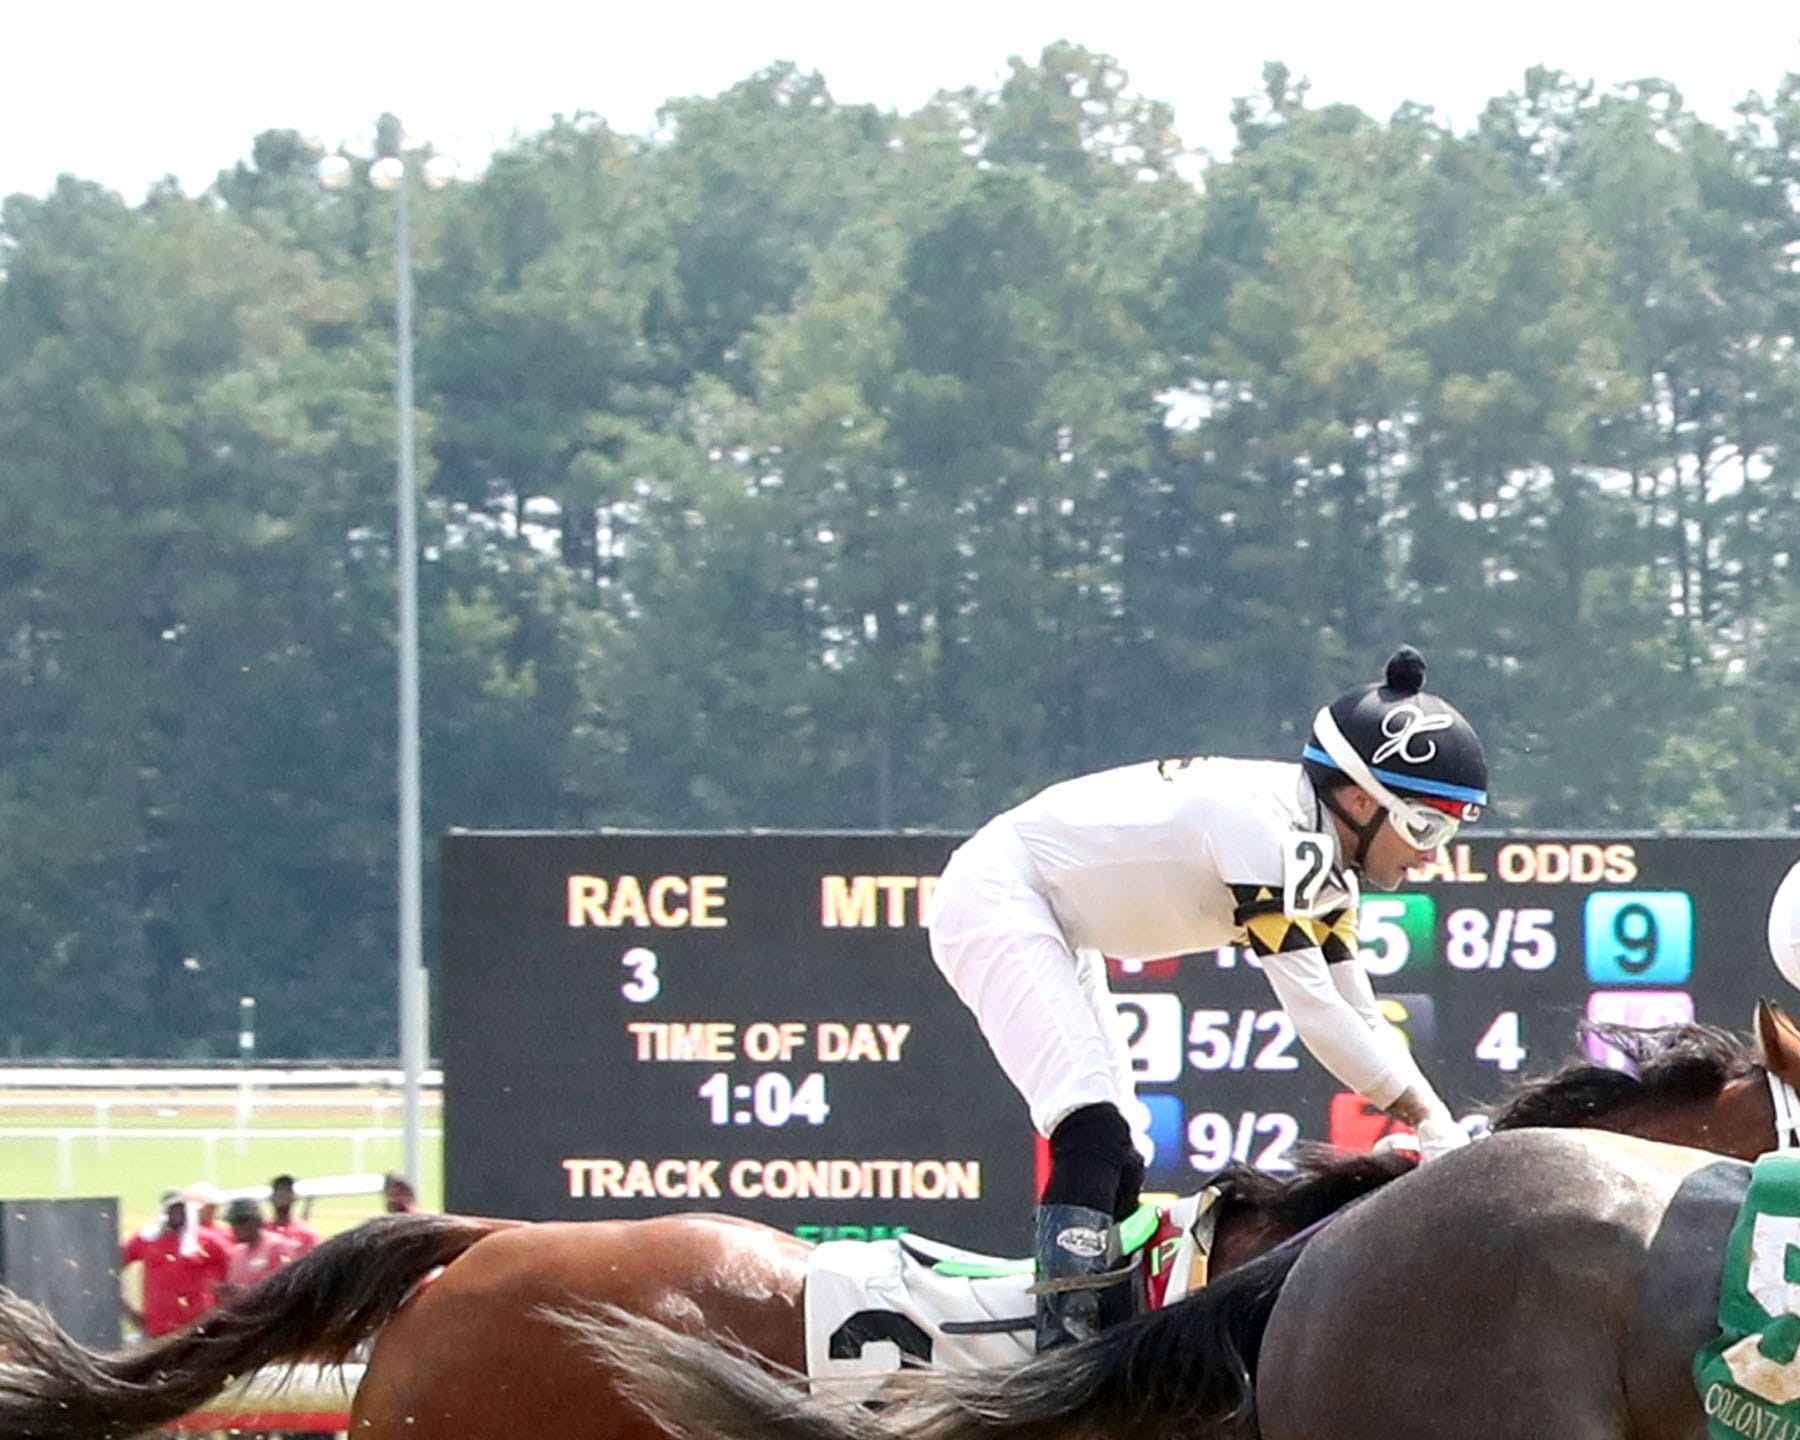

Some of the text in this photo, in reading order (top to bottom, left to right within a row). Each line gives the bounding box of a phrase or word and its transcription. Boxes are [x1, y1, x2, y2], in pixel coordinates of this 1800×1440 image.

[1293, 840, 1324, 911] 2
[1499, 844, 1637, 883] ODDS
[567, 876, 728, 928] RACE
[1446, 909, 1557, 970] 8/5
[1614, 903, 1659, 974] 9
[620, 948, 661, 1003] 3
[627, 1024, 910, 1062] TIME OF DAY
[1187, 1009, 1299, 1071] 5/2
[1475, 1011, 1526, 1071] 4
[699, 1072, 830, 1127] 1:04
[1187, 1111, 1299, 1172] 9/2
[563, 1159, 980, 1199] TRACK CONDITION
